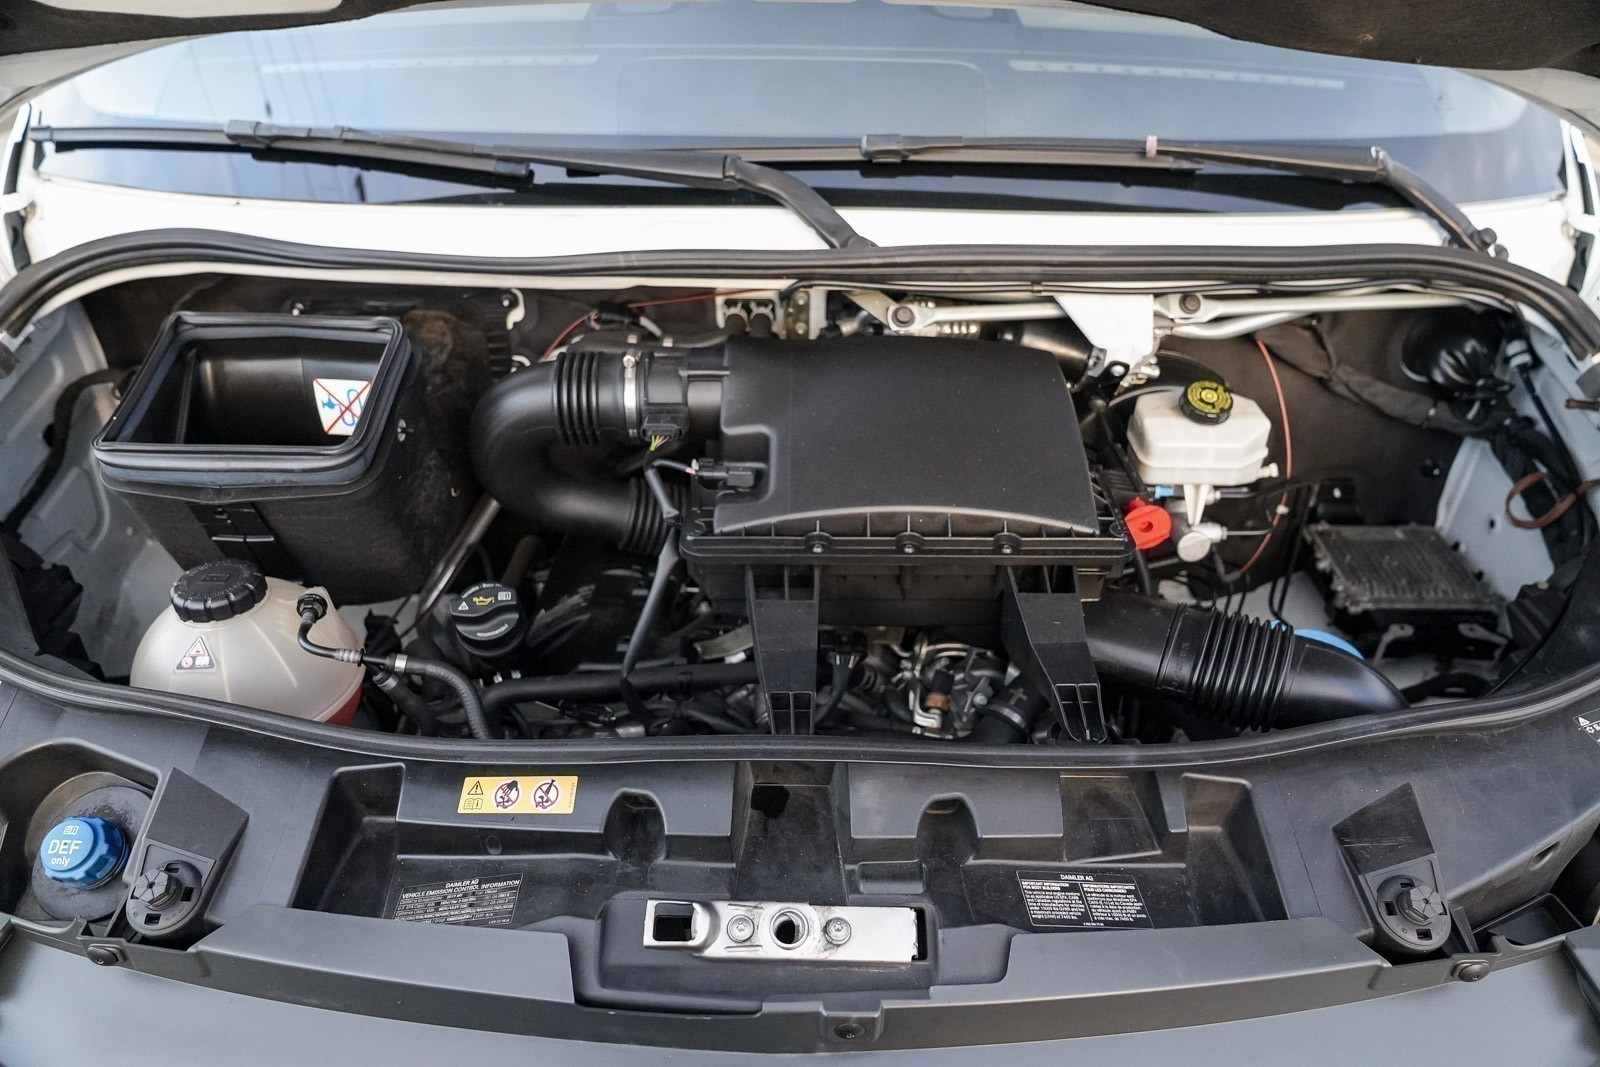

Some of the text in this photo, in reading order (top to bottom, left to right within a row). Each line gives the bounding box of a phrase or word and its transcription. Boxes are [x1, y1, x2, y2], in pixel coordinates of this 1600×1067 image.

[47, 839, 82, 855] DEF
[51, 856, 70, 868] only
[426, 888, 454, 896] EMISSION
[454, 884, 480, 893] CONTROL
[480, 880, 520, 890] INFORMATION
[446, 880, 470, 888] DAIMLER
